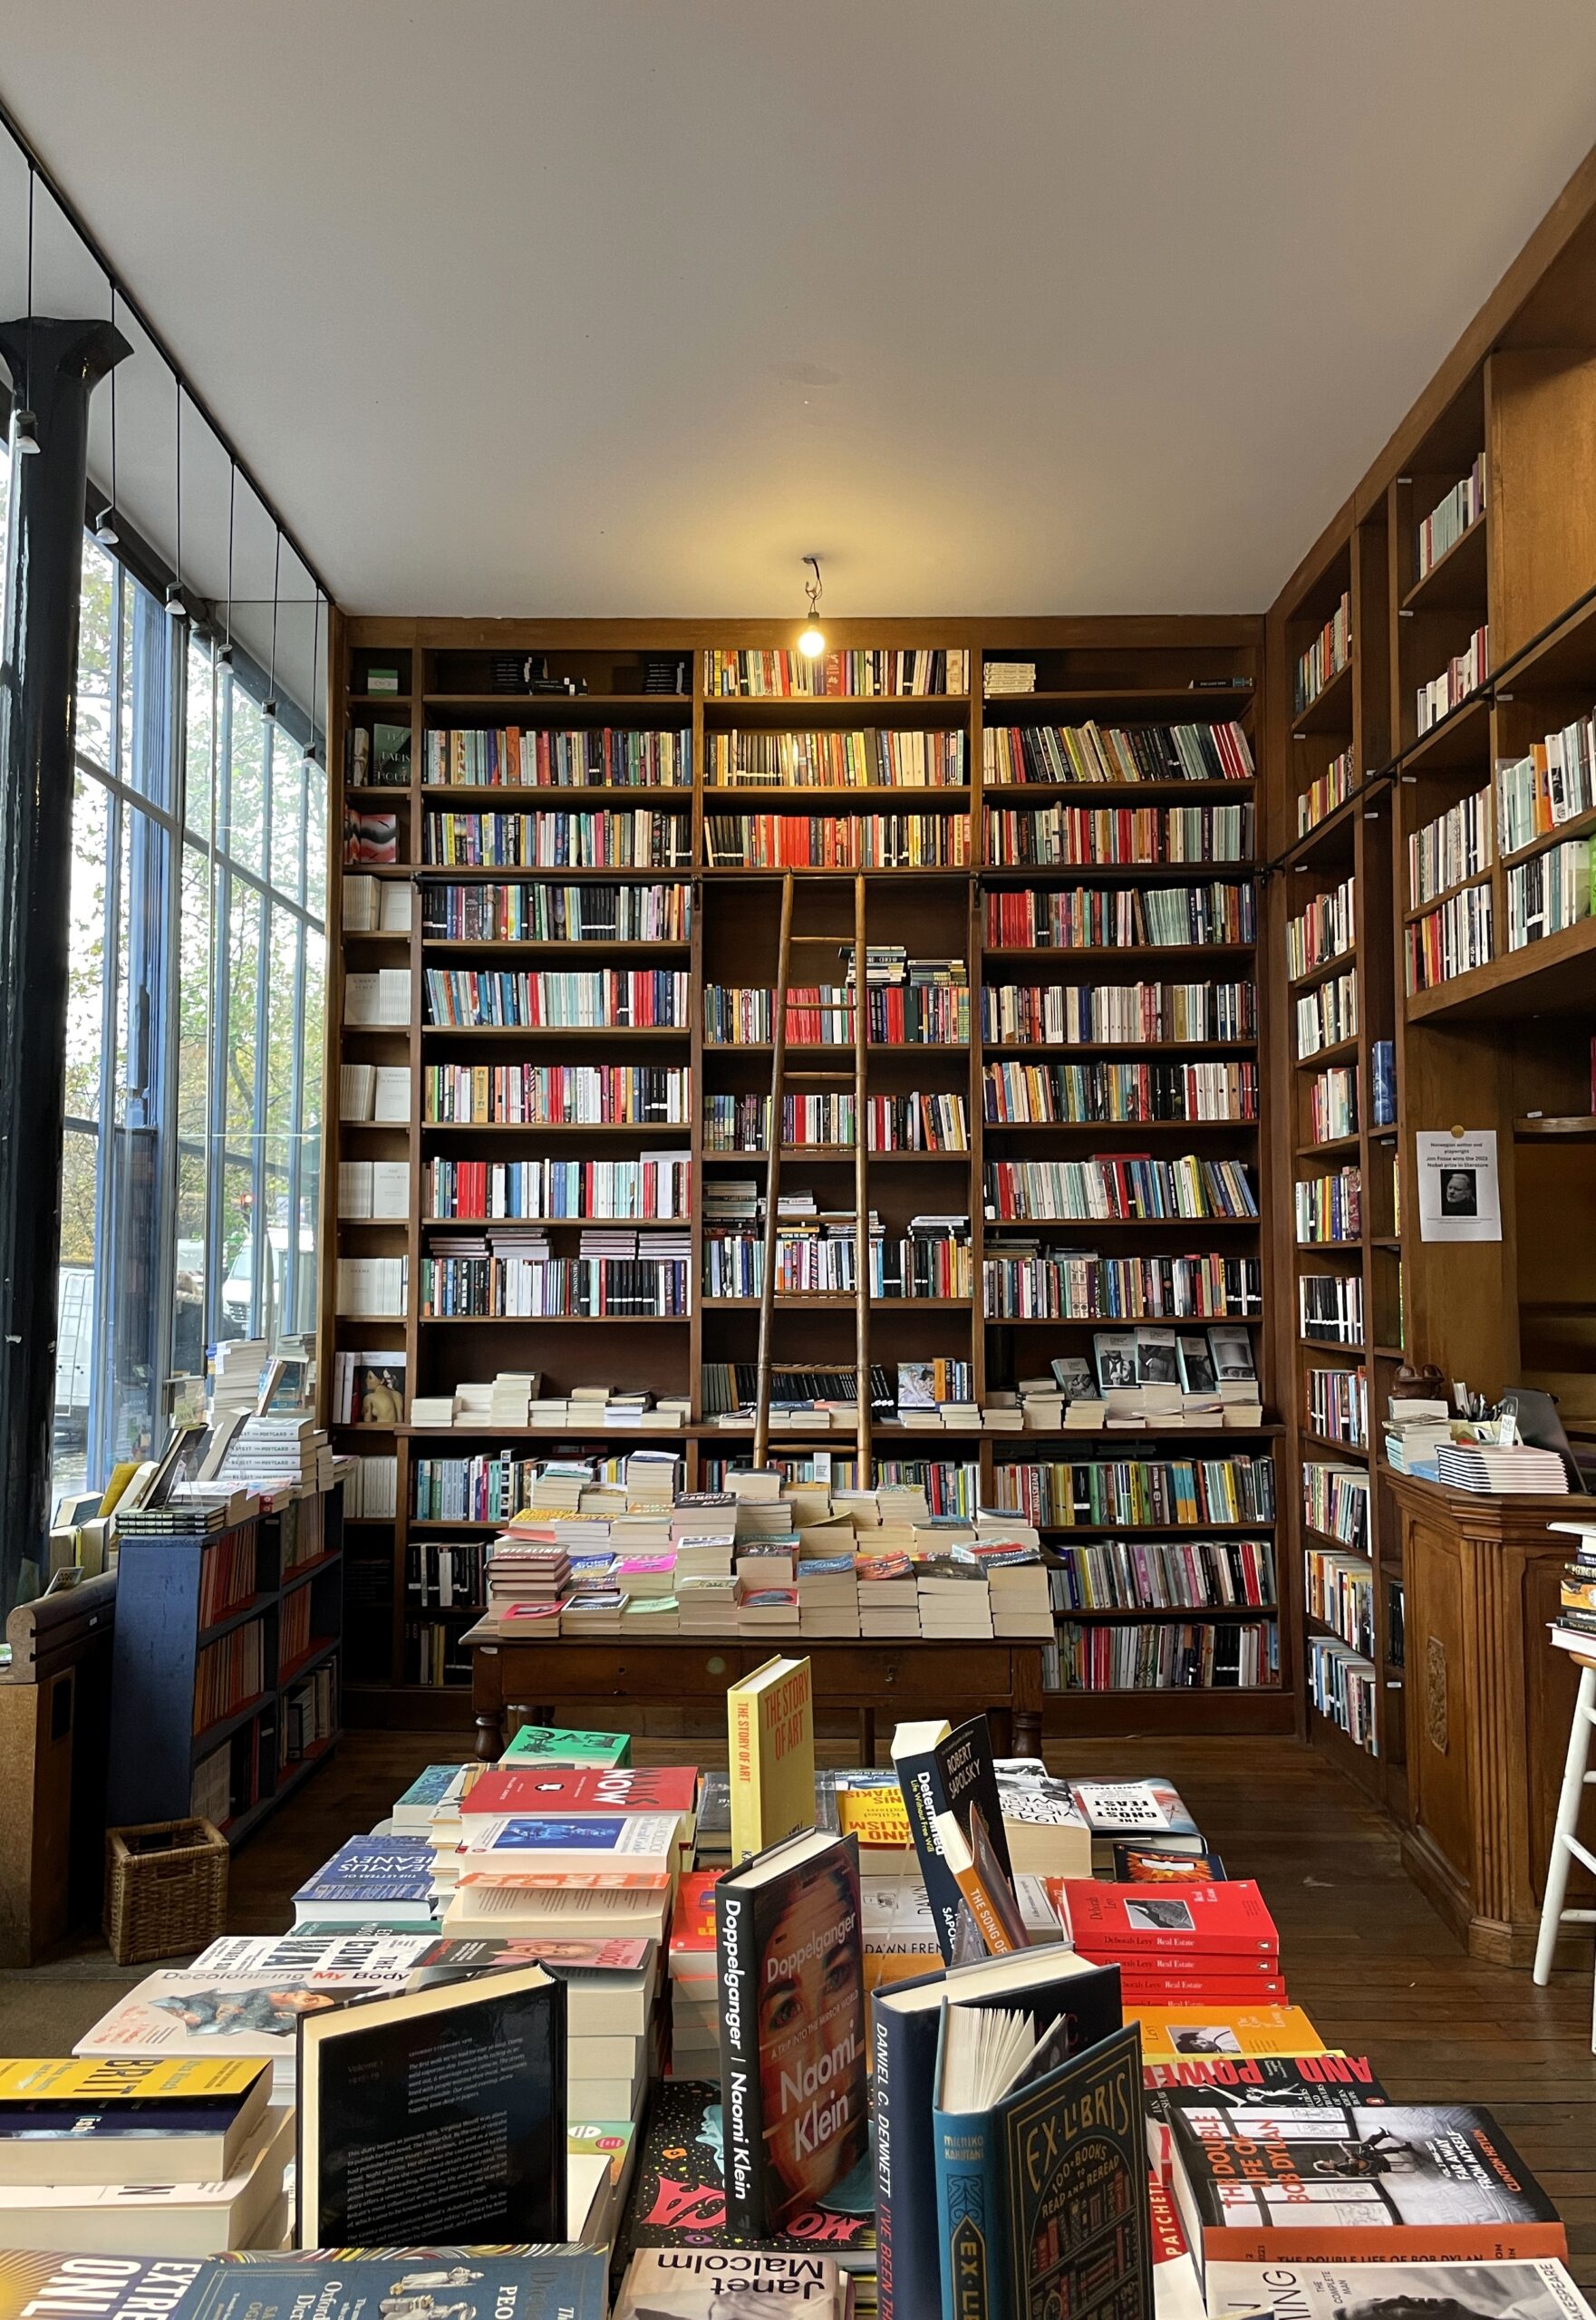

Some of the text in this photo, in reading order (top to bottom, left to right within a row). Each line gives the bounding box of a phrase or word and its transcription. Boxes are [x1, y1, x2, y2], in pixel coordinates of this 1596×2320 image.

[1031, 1472, 1040, 1513] OVERSTORY
[765, 1668, 809, 1730] THE STORY
[737, 1702, 751, 1784] THE STORY OF ART
[775, 1709, 803, 1761] OF ART
[946, 1742, 972, 1775] ROBERT
[593, 1769, 636, 1805] NOW
[948, 1758, 981, 1799] SAPOLSKY
[910, 1780, 934, 1852] Life Without Free Will
[344, 1855, 434, 1863] HEANEY
[970, 1888, 1008, 1953] THE SONG OF
[767, 1912, 856, 1983] Doppelganger
[865, 1943, 906, 1953] DAWN
[1104, 1937, 1136, 1945] Deborah
[1137, 1937, 1153, 1946] Levy
[161, 1971, 411, 1982] Decolonising My Body
[372, 1956, 399, 1969] THE
[1137, 1960, 1153, 1968] Levy
[772, 1989, 859, 2060] A TRIP INTO THE MIRROR WORLD
[722, 1899, 751, 2201] Doppelganger Naomi Klein
[779, 2018, 856, 2115] Naomi
[876, 2023, 889, 2084] DANIEL
[72, 2058, 165, 2095] BRIT
[1294, 2056, 1373, 2083] AND
[877, 2091, 889, 2107] C.
[1151, 2100, 1162, 2113] IAN
[794, 2089, 849, 2161] Klein
[943, 2135, 984, 2147] MICHIKO
[1026, 2073, 1129, 2195] EX LIBRIS
[348, 2149, 359, 2158] This
[361, 2144, 375, 2154] diary
[403, 2132, 424, 2143] January
[354, 2153, 373, 2165] publish
[878, 2113, 891, 2199] DENNETT
[944, 2148, 984, 2161] KAKUTANI
[1074, 2142, 1108, 2167] BOOKS
[1195, 2115, 1247, 2209] THE DOUBLE
[1230, 2133, 1272, 2188] LIFE OF
[1254, 2120, 1311, 2204] BOB DYLAN
[1434, 2137, 1471, 2181] FAR AWAY
[1446, 2130, 1495, 2190] FROM MYSELF
[1471, 2129, 1523, 2192] CLINTON HEYLIN
[347, 2155, 402, 2176] had published many
[1077, 2167, 1086, 2177] TO
[347, 2196, 379, 2211] diary offers
[384, 2183, 395, 2192] and
[1041, 2153, 1120, 2219] READ AND REREAD
[880, 2204, 892, 2241] I'VE
[657, 2253, 824, 2279] Malcolm
[881, 2243, 893, 2295] BEEN
[961, 2242, 979, 2276] EX
[313, 2281, 343, 2320] Oxford
[711, 2275, 826, 2300] Janet
[1313, 2280, 1324, 2293] THE
[1320, 2271, 1343, 2305] COMPLETE
[1338, 2279, 1352, 2295] MAN
